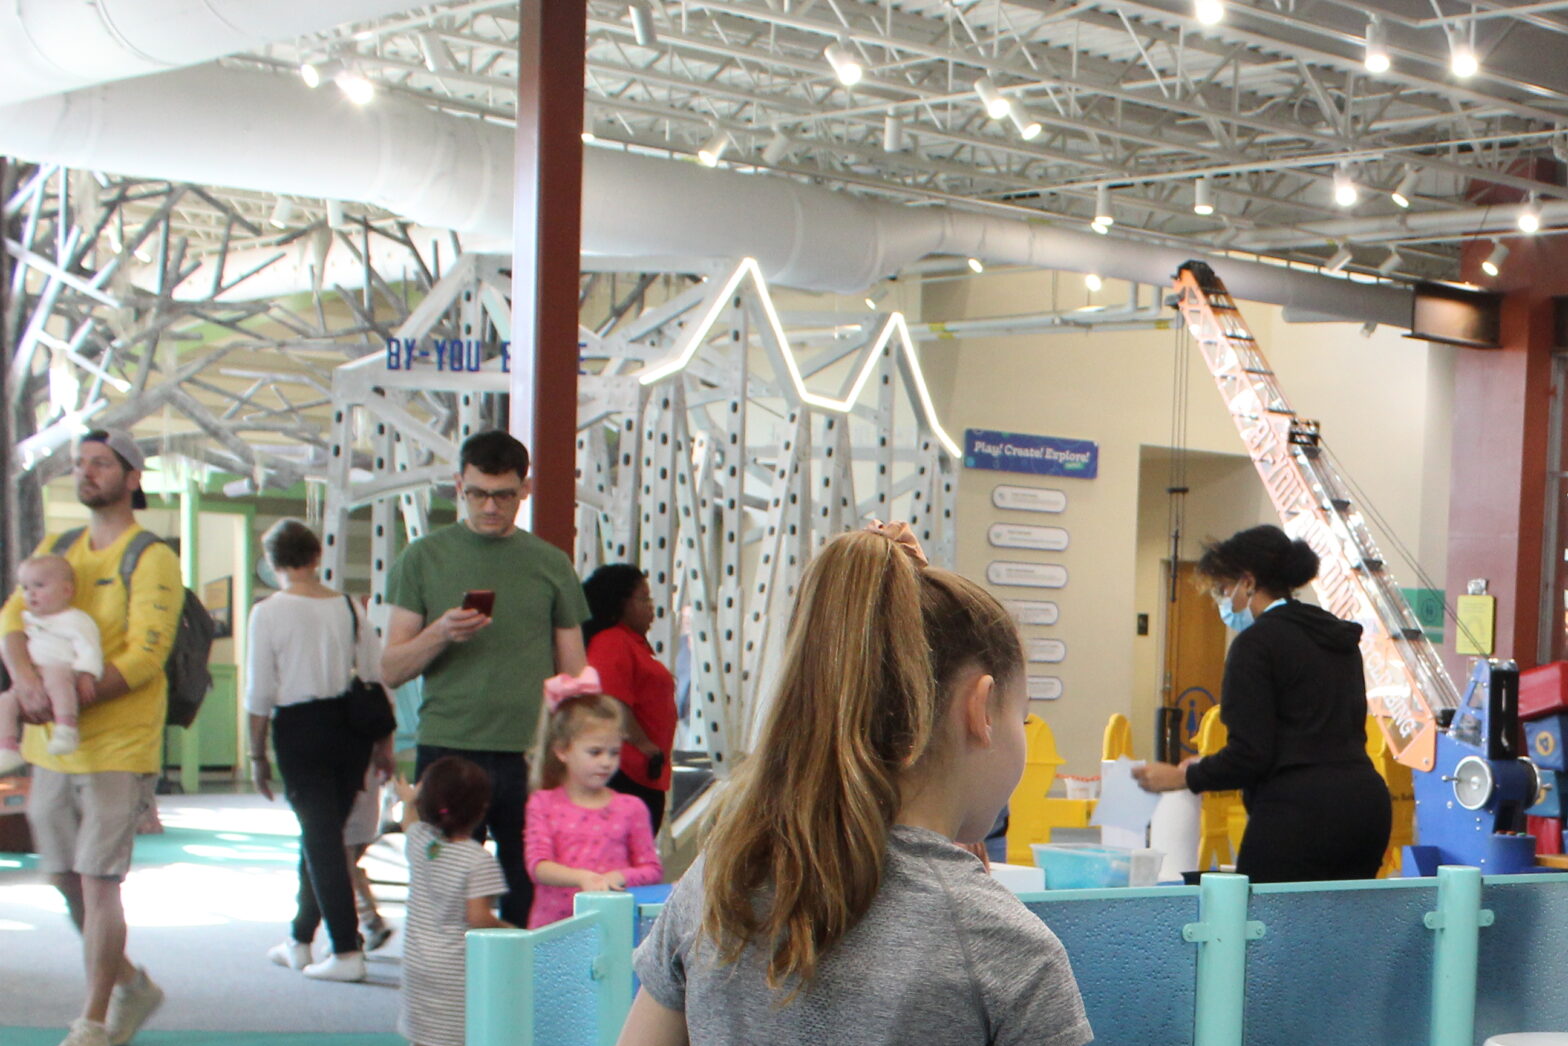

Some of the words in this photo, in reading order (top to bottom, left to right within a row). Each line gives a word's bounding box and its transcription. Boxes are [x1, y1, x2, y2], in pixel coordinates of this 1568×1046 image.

[386, 337, 481, 373] BY-YOU
[1004, 445, 1043, 459] Create!
[1045, 449, 1090, 463] Explore!
